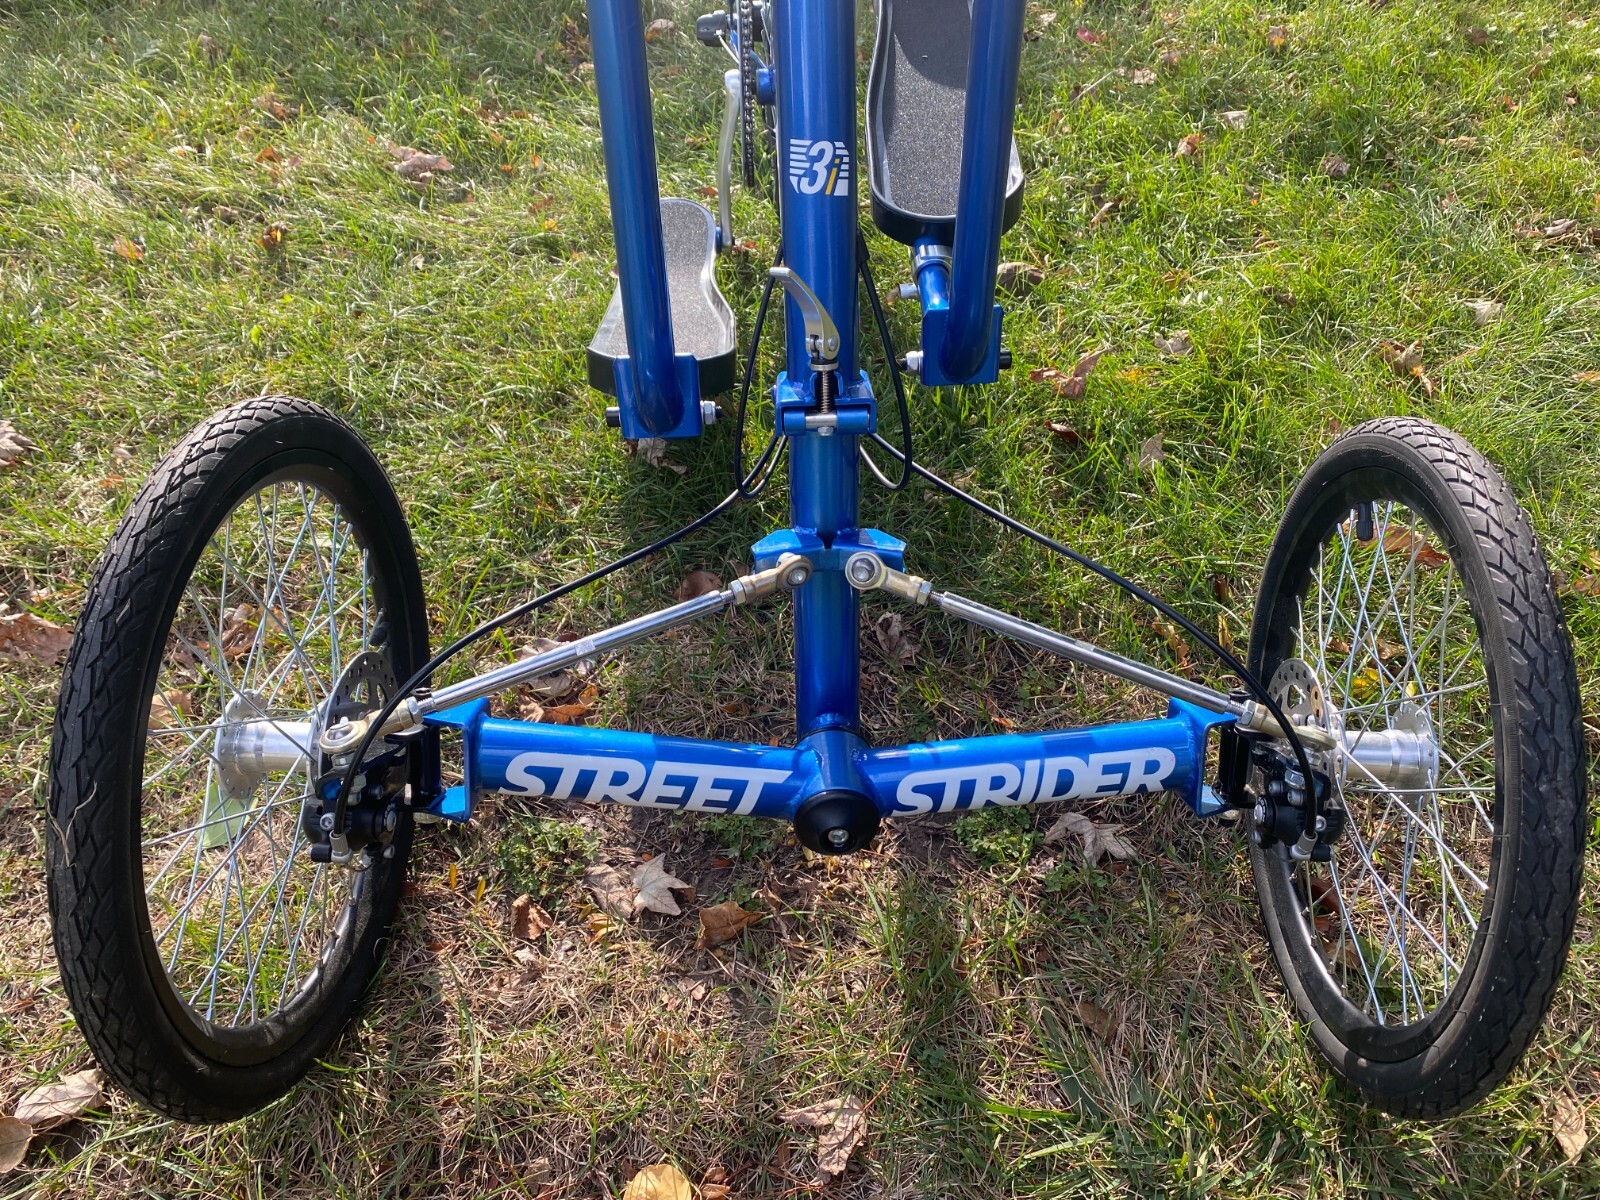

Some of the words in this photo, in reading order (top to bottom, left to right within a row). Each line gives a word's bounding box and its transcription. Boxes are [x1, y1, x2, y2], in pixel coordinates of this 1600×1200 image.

[800, 140, 840, 195] 3i
[497, 751, 793, 815] STREET
[892, 747, 1176, 817] STRIDER
